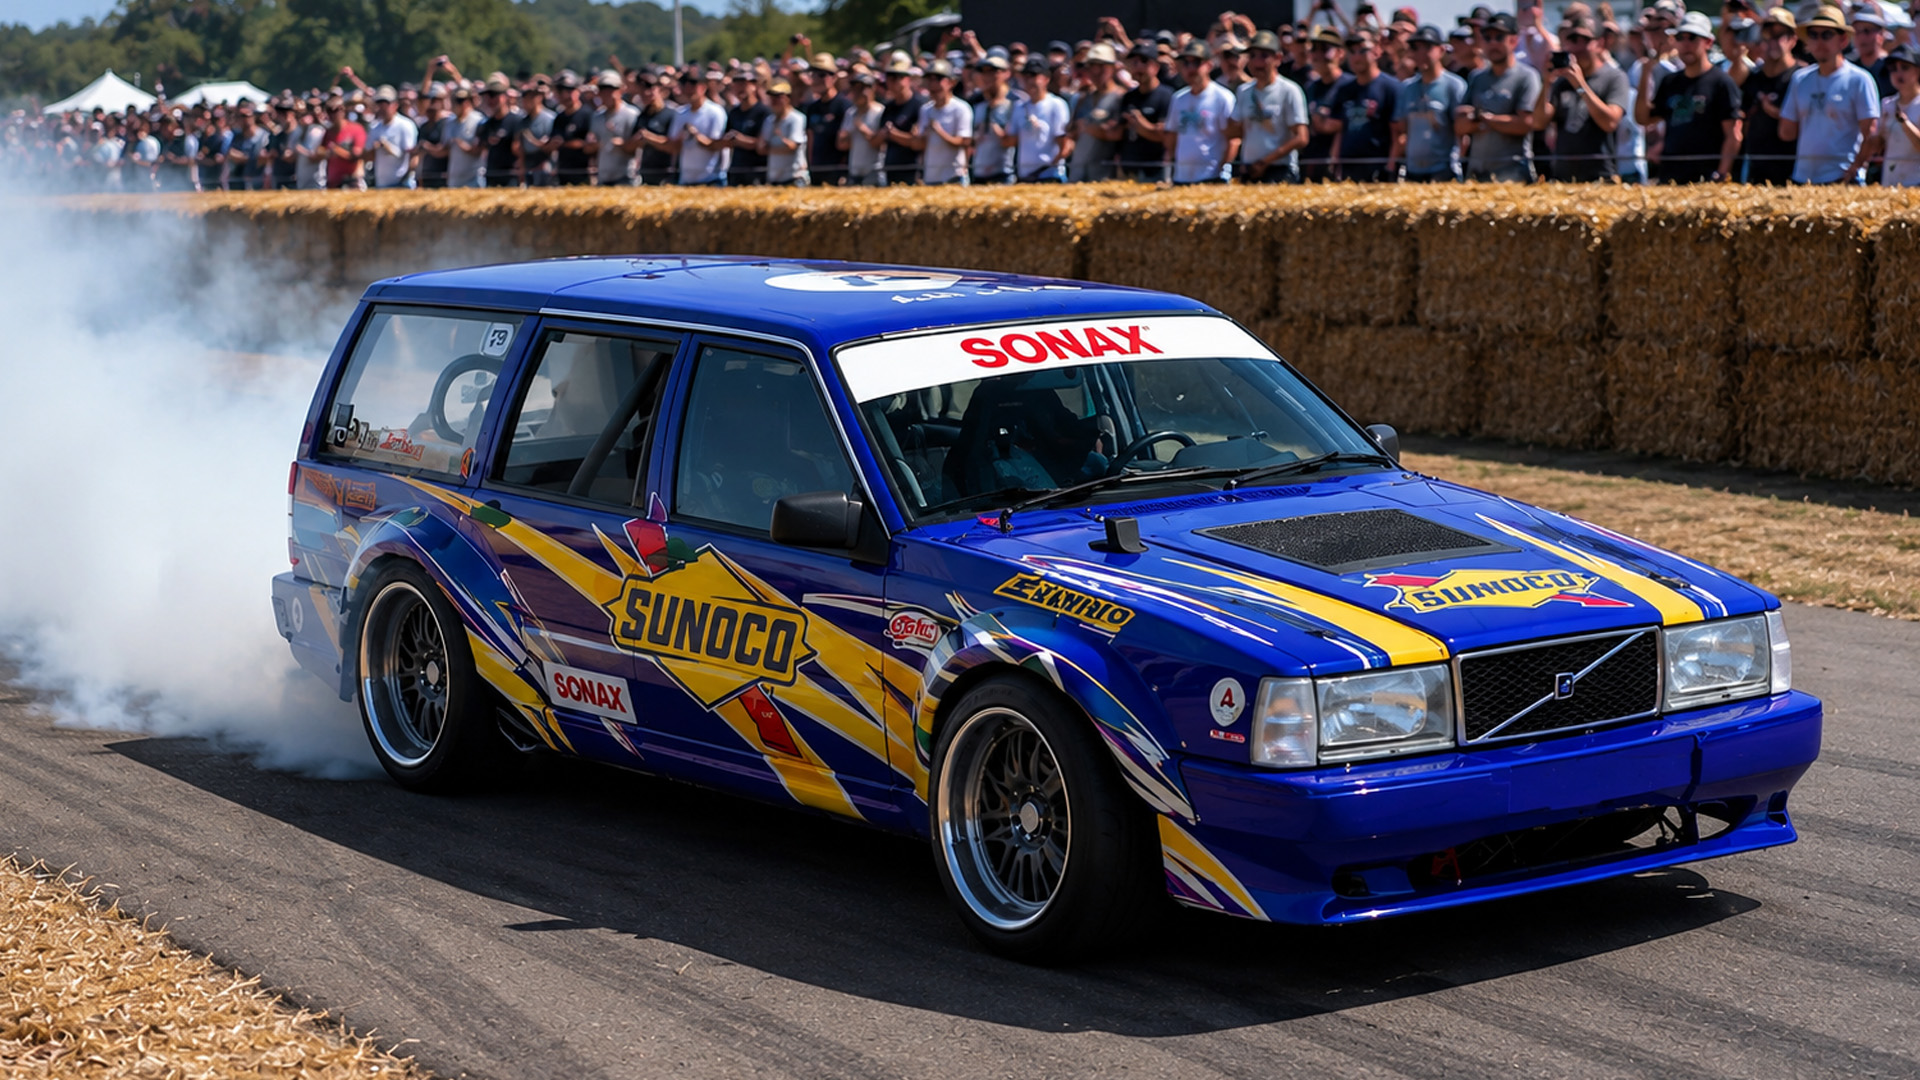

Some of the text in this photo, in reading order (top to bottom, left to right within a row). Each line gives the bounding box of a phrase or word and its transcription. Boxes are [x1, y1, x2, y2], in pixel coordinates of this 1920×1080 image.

[960, 325, 1164, 368] SONAX
[620, 587, 798, 674] SUNOCO
[554, 672, 627, 714] SONAX
